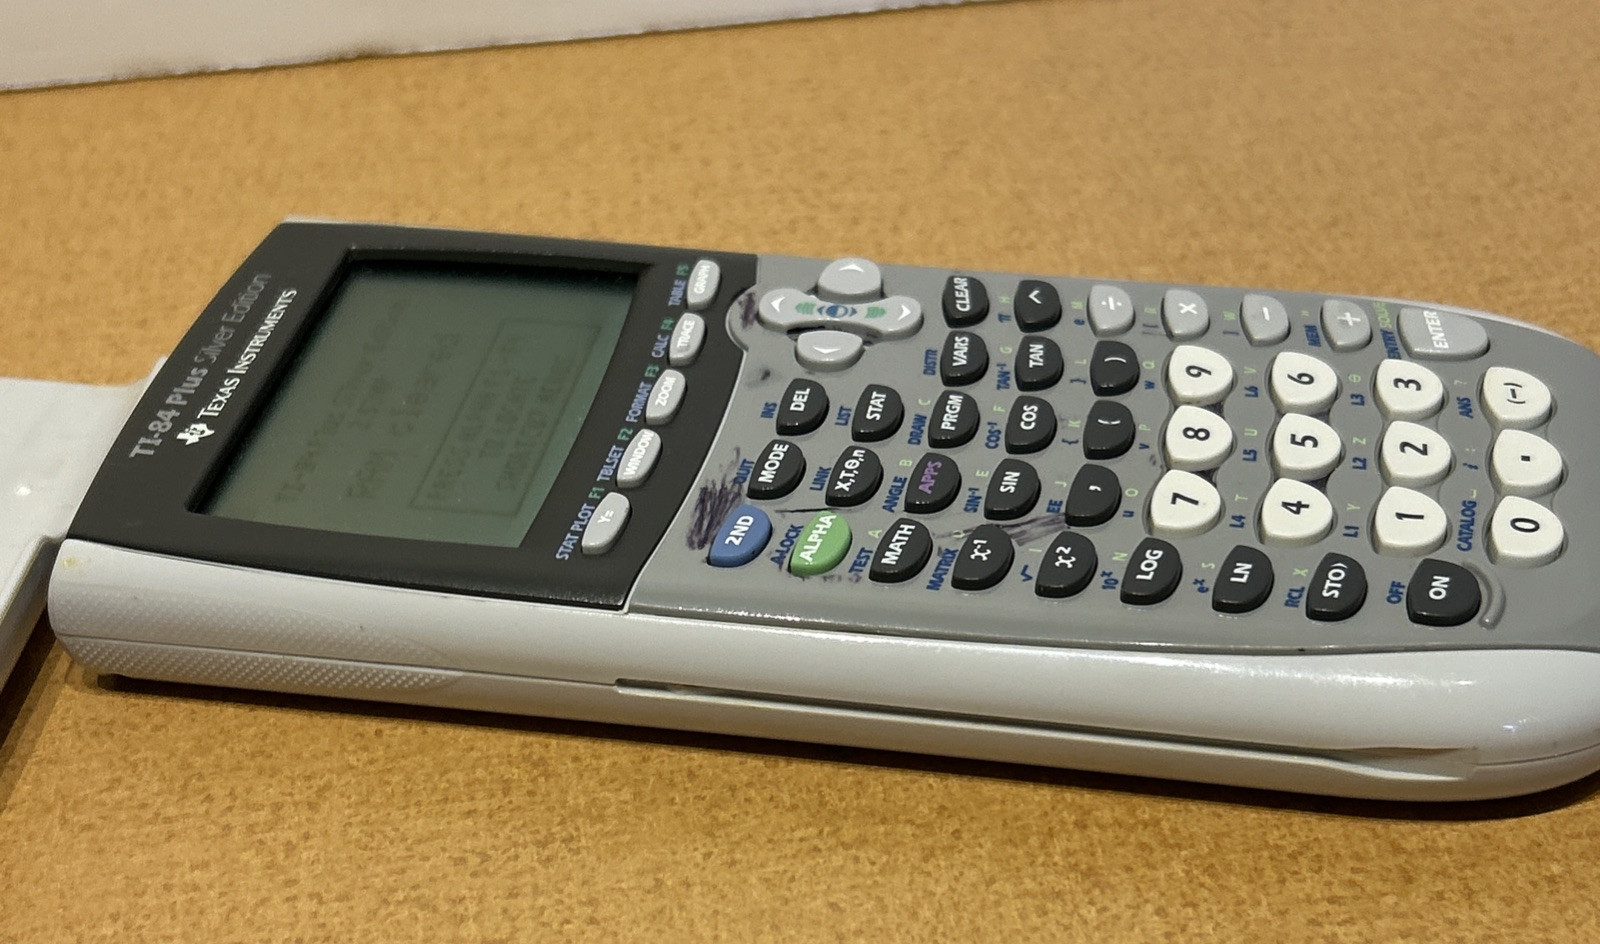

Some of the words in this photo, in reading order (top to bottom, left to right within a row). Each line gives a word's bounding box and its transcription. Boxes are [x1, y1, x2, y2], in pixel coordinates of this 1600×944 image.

[694, 264, 710, 294] GRAPH
[669, 279, 687, 306] TABLE
[953, 277, 970, 311] CLEAR
[677, 319, 695, 348] TRACE
[1423, 310, 1449, 349] ENTER
[197, 377, 240, 419] TEXAS
[227, 288, 298, 374] INSTRUMENTS
[652, 334, 669, 358] CALC
[952, 336, 969, 366] VARS
[1029, 344, 1044, 368] TAN
[129, 407, 180, 458] TI-84
[166, 367, 208, 405] Plus
[194, 326, 236, 364] Silver
[221, 272, 272, 323] Edition
[644, 365, 660, 378] F3
[923, 349, 937, 375] DISTR
[1185, 365, 1212, 378] 9
[655, 376, 677, 406] ZOOM
[1287, 372, 1314, 385] 6
[1393, 377, 1422, 391] 3
[625, 381, 652, 423] FORMAT
[761, 402, 777, 418] INS
[790, 387, 810, 412] DEL
[865, 392, 887, 420] STAT
[941, 394, 964, 430] PRGM
[993, 404, 1006, 412] F
[1456, 397, 1473, 419] ANS
[835, 406, 852, 426] LIST
[1020, 404, 1038, 430] COS
[617, 427, 634, 441] F2
[908, 414, 927, 445] DRAW
[1182, 427, 1210, 441] 8
[1290, 433, 1319, 448] 5
[624, 431, 654, 476] WINDOW
[1400, 441, 1428, 457] 2
[596, 446, 624, 482] TBLSET
[758, 443, 789, 484] MODE
[899, 459, 913, 467] B
[975, 469, 990, 477] E
[809, 466, 831, 491] LINK
[918, 461, 942, 494] APPS
[999, 471, 1021, 493] SIN
[588, 487, 605, 500] F1
[882, 476, 908, 513] ANGLE
[1046, 499, 1063, 513] EE
[1171, 492, 1199, 506] 7
[597, 510, 615, 524] Y=
[1281, 500, 1310, 515] 4
[1395, 511, 1425, 521] 1
[556, 532, 581, 560] STAT
[570, 503, 597, 534] PLOT
[724, 515, 755, 547] 2ND
[868, 529, 882, 539] A
[1457, 500, 1477, 552] CATALOG
[1510, 517, 1540, 533] 0
[770, 524, 804, 566] A-LOCK
[800, 513, 837, 563] ALPHA
[881, 523, 916, 565] MATH
[848, 547, 873, 574] TEST
[1112, 552, 1128, 561] N
[1136, 549, 1164, 581] LOG
[926, 548, 959, 591] MATRIX
[1230, 562, 1253, 584] LN
[1284, 586, 1305, 608] RCL
[1386, 581, 1406, 604] OFF
[1429, 576, 1450, 600] ON
